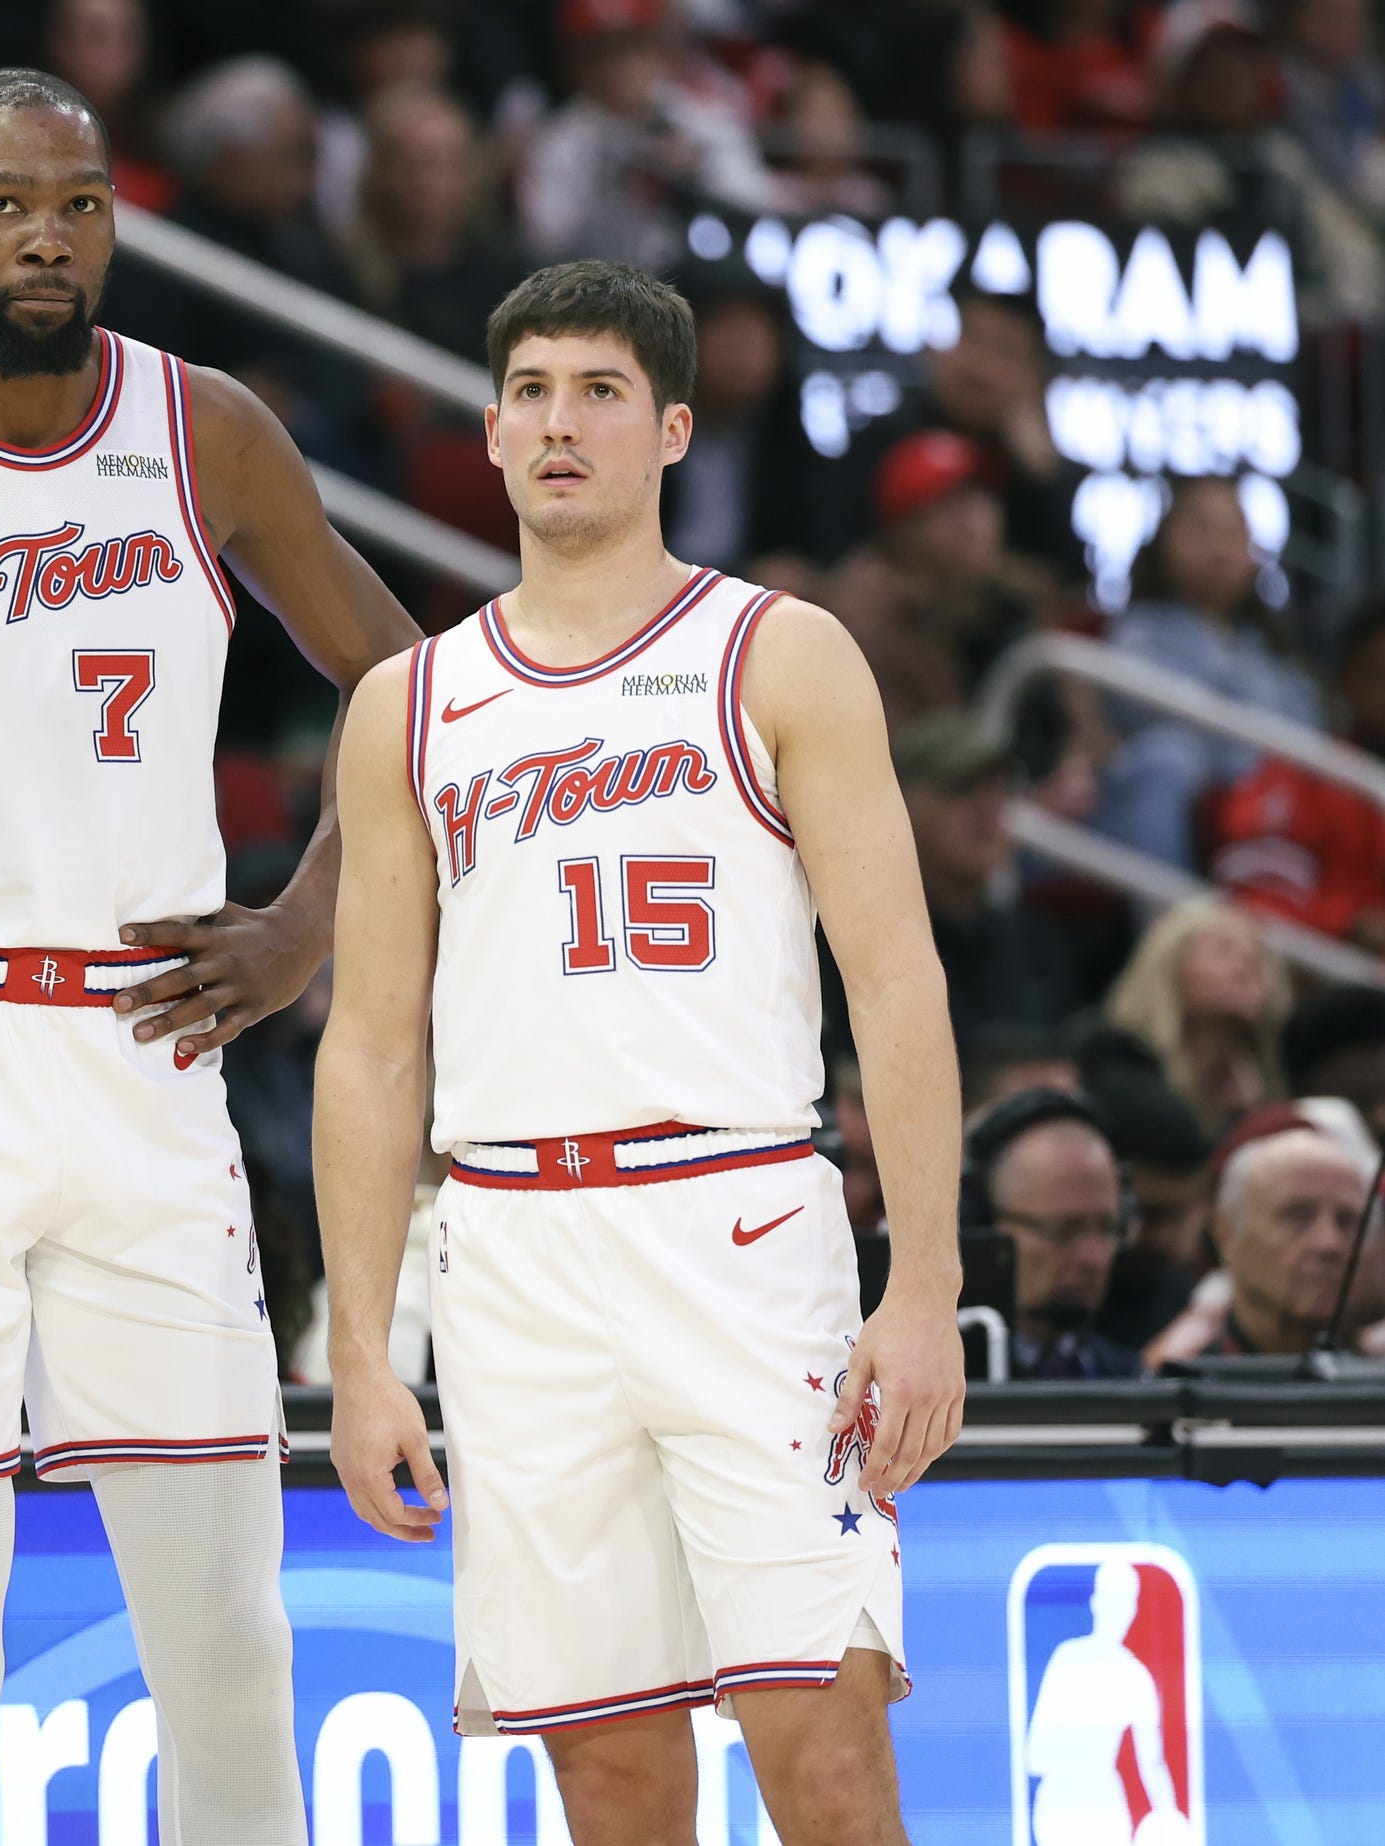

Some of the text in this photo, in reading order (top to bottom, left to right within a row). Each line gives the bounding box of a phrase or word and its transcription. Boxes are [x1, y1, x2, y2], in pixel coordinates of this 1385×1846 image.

[96, 453, 168, 469] MEMORIAL
[97, 464, 169, 480] HERMANN
[622, 672, 708, 687] MEMORIAL
[621, 681, 708, 697] HERMANN
[72, 649, 156, 763] 7
[434, 737, 717, 888] H-Town
[557, 855, 716, 976] 15
